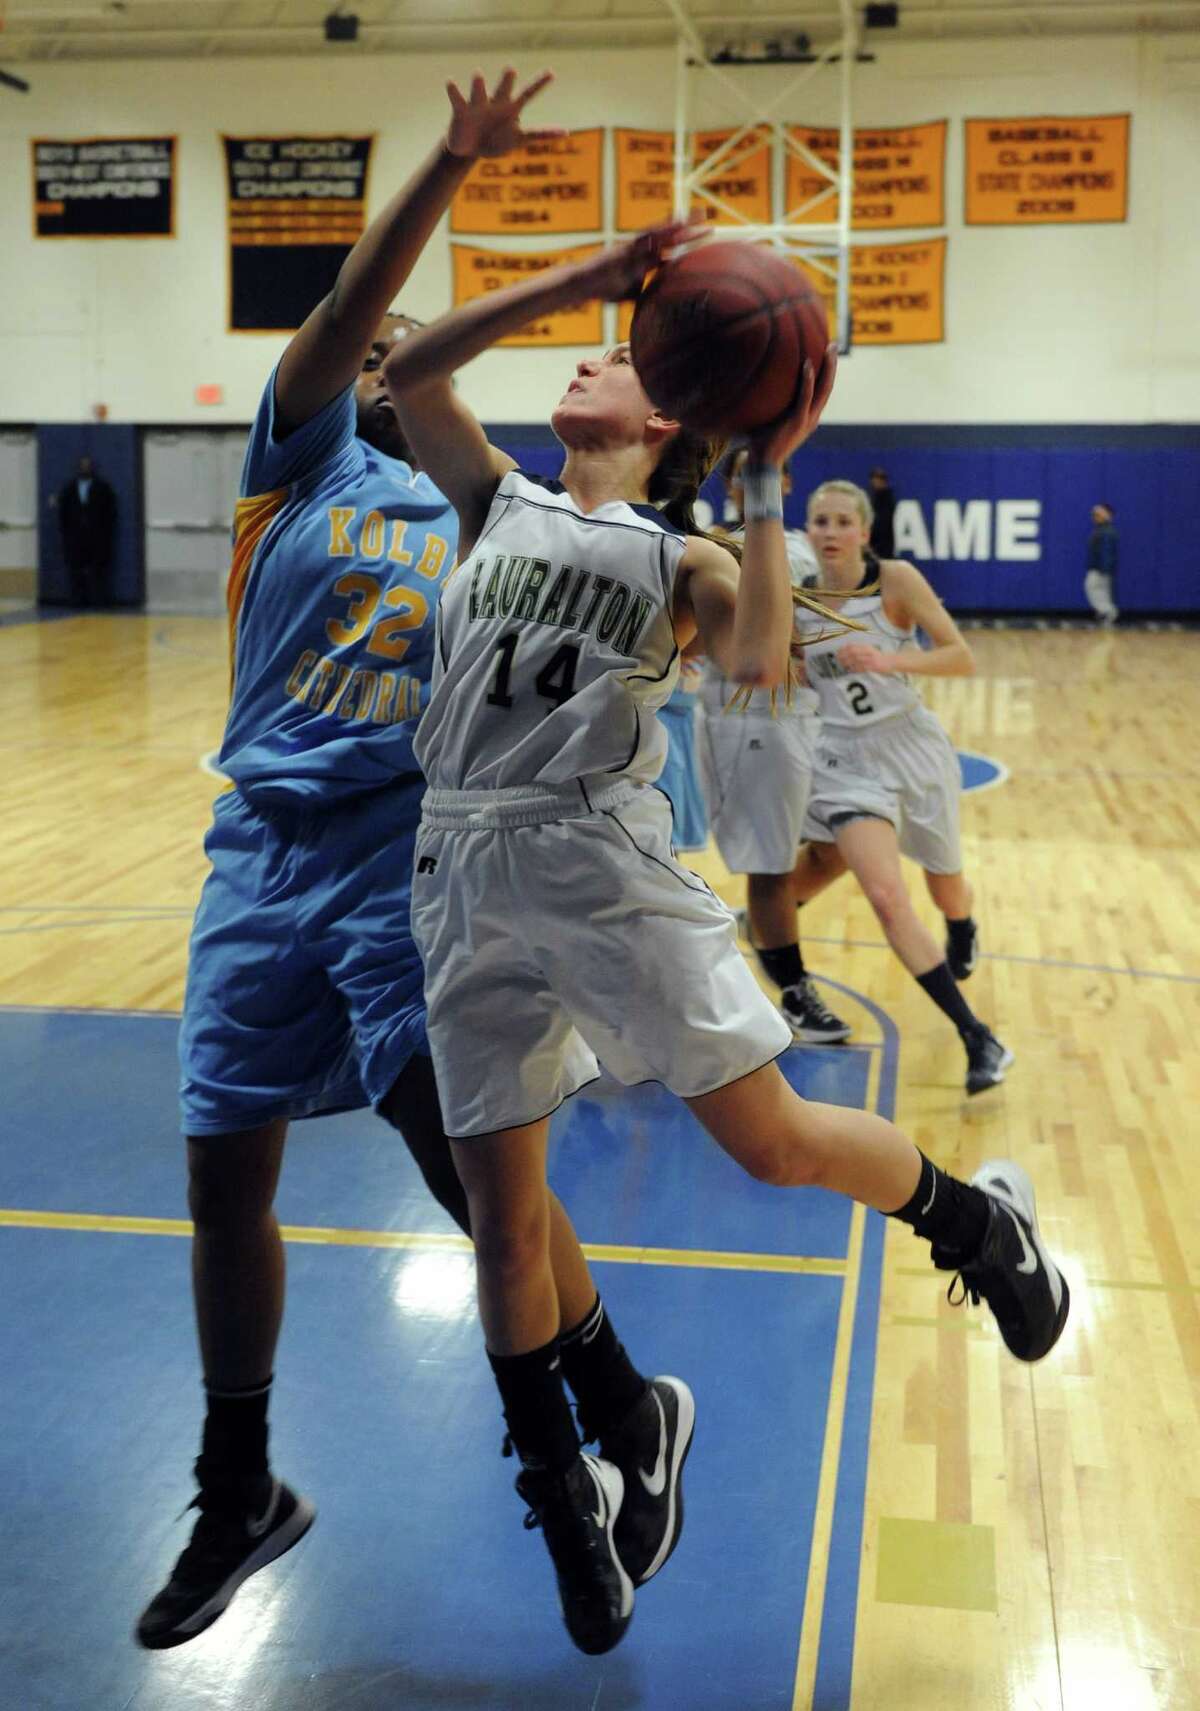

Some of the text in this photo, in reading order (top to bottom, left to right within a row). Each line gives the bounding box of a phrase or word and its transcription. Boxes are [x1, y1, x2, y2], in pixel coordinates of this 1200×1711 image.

[808, 135, 922, 149] BAEBALL
[327, 506, 458, 590] KOLB
[325, 573, 430, 661] 32
[486, 632, 581, 715] 14
[846, 681, 875, 716] 2
